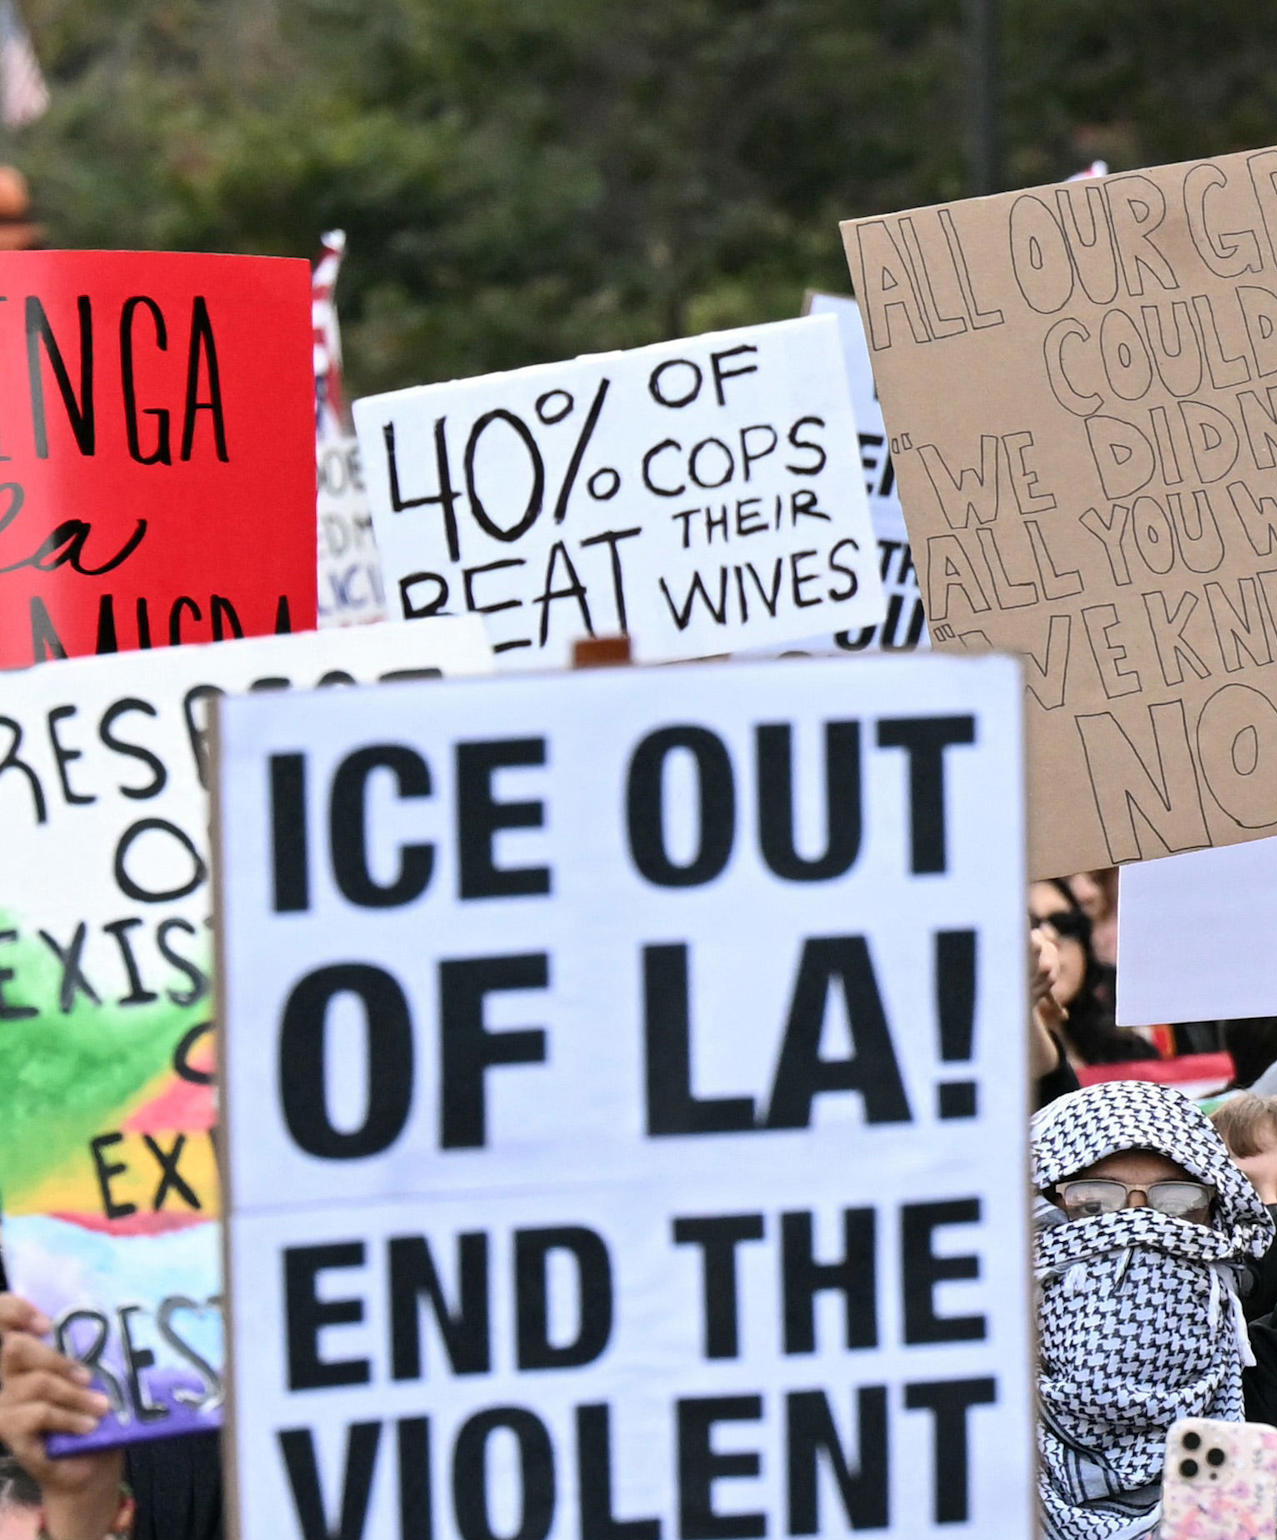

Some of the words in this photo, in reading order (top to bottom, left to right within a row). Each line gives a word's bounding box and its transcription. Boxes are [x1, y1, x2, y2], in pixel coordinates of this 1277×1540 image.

[856, 210, 1004, 351] ALL
[1009, 176, 1180, 315] OUR
[0, 295, 229, 466] NGA
[382, 378, 620, 562] 40%
[649, 344, 759, 409] OF
[642, 415, 828, 498] COPS
[399, 526, 643, 655] BEAT
[672, 489, 832, 549] THEIR
[658, 538, 861, 633] WIVES
[927, 519, 1084, 622] ALL
[1079, 489, 1226, 586] YOU
[266, 735, 553, 915] ICE
[625, 714, 978, 888] OUT
[0, 916, 214, 1019] EXIS
[277, 951, 550, 1160] OF
[641, 929, 981, 1139] LA!
[54, 1296, 225, 1424] RES
[281, 1222, 614, 1392] END
[671, 1198, 989, 1360] THE
